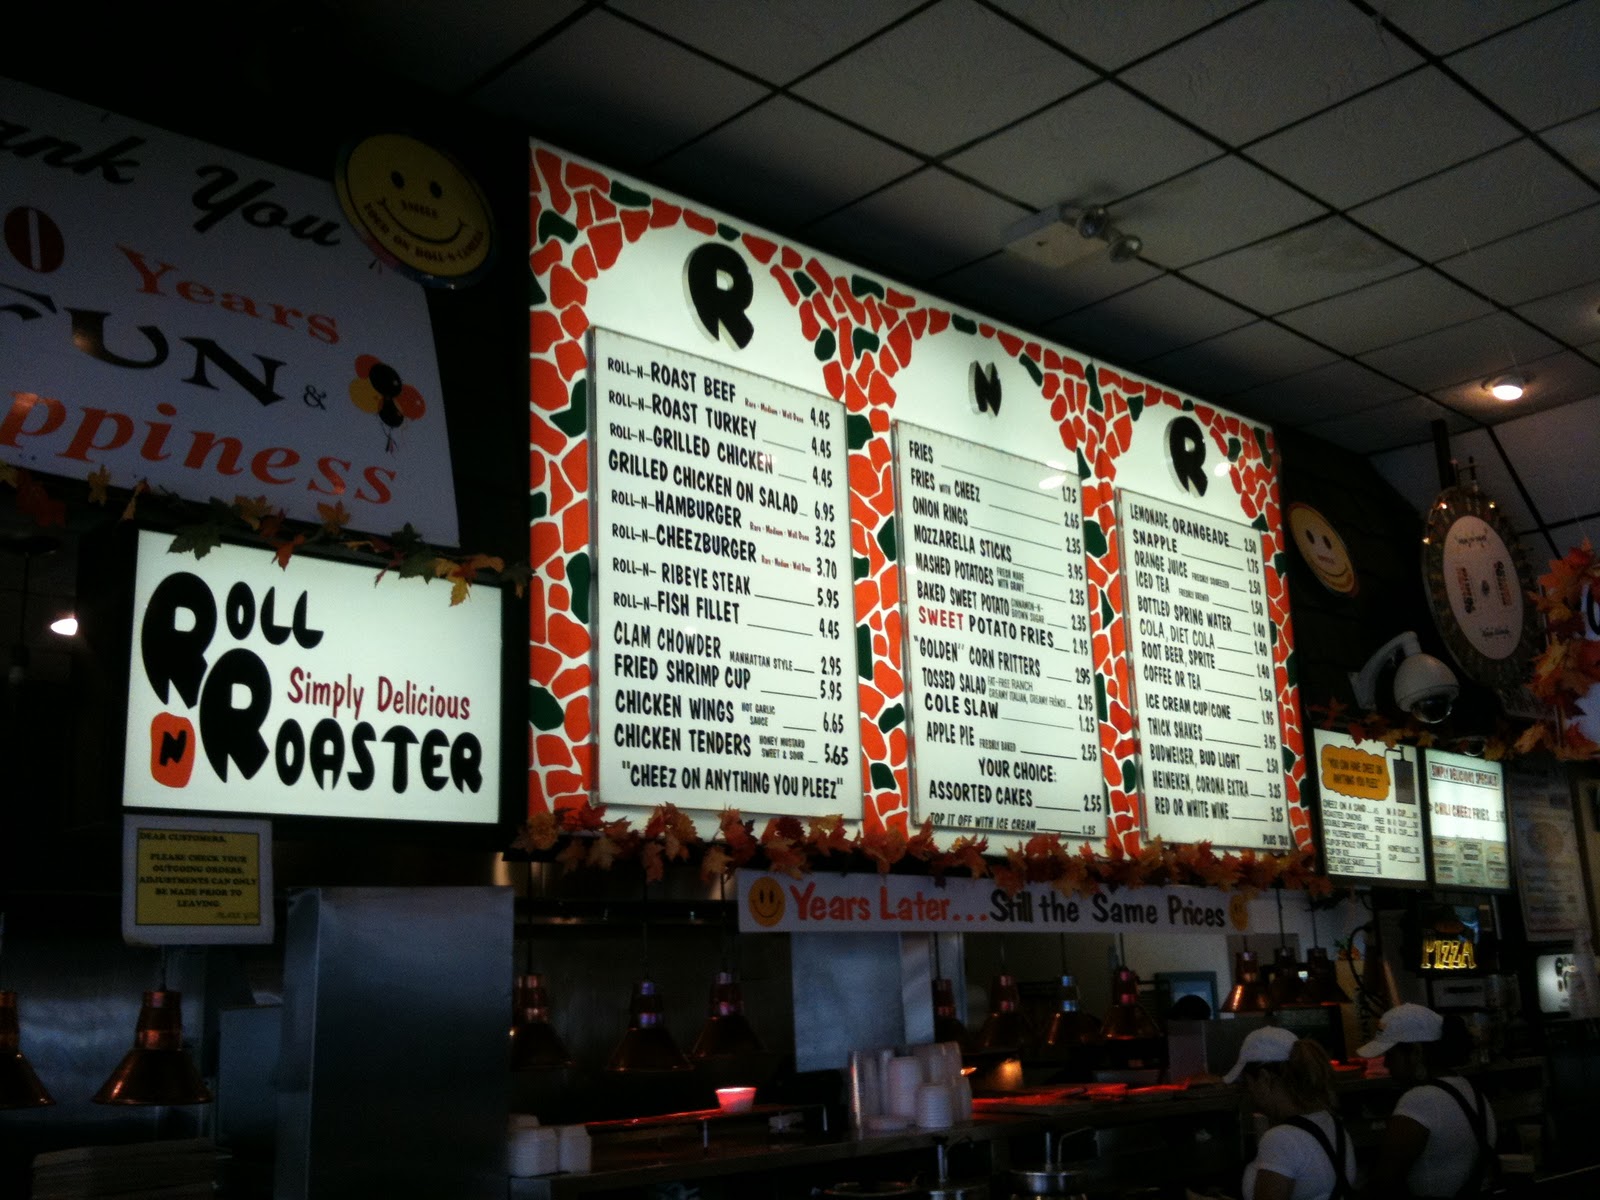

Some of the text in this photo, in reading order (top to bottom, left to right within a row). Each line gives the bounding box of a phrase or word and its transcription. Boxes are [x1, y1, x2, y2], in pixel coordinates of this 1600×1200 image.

[192, 165, 341, 247] You
[115, 243, 340, 345] Years
[688, 242, 754, 349] R
[303, 385, 327, 411] &
[703, 375, 736, 403] BEEF
[810, 407, 830, 430] 4.45
[970, 361, 1003, 417] N
[705, 407, 756, 440] TURKEY
[811, 436, 832, 459] 4.45
[716, 441, 773, 474] CHICKEN
[812, 465, 833, 488] 4.45
[908, 440, 933, 464] FRIES
[1167, 416, 1208, 498] R
[608, 448, 835, 522] GRILLED CHICKEN ON SALAD 6.95
[910, 467, 980, 503] FRIES CHEEZ
[912, 495, 968, 526] ONION RINGS
[815, 525, 836, 549] 3.25
[913, 524, 1012, 563] MOZZARELLA STICKS
[1132, 528, 1177, 553] SNAPPLE
[1172, 516, 1230, 548] ORANGEADE
[816, 556, 837, 580] 3.70
[915, 552, 994, 586] MASHED POTATOES
[1134, 549, 1188, 578] ORANGE JUICE
[661, 562, 708, 589] RIBEYE
[711, 570, 751, 595] STEAK
[817, 587, 839, 609] 5.95
[916, 579, 1010, 617] BAKED SWEET POTATO
[1135, 570, 1153, 589] ICED
[1155, 574, 1170, 593] TEA
[696, 596, 740, 624] FILLET
[819, 617, 840, 640] 4.45
[918, 605, 963, 630] SWEET
[968, 614, 1017, 640] POTATO
[1020, 625, 1054, 648] FRIES
[1137, 594, 1170, 617] BOTTLED
[1173, 604, 1203, 626] SPRING
[1206, 612, 1232, 632] WATER
[141, 571, 324, 709] ROLL
[613, 620, 842, 676] CLAM CHOWDER MANHATTAN STYLE 2.95
[1169, 625, 1189, 644] DIET
[1192, 629, 1215, 649] COLA
[968, 645, 995, 669] CORN
[997, 651, 1040, 678] FRITTERS
[1141, 640, 1162, 660] ROOT
[1188, 649, 1215, 669] SPRITE
[287, 666, 471, 720] Simply Delicious
[614, 653, 842, 701] FRIED SHRIMP CUP 5.95
[921, 666, 955, 690] TOSSED
[959, 672, 986, 695] SALAD
[1143, 664, 1201, 690] COFFEE OR TEA
[615, 689, 844, 734] CHICKEN WINGS 6.65
[924, 692, 960, 714] COLE
[963, 697, 998, 719] SLAW
[1145, 692, 1160, 709] ICE
[1161, 695, 1191, 713] CREAM
[159, 648, 483, 794] N ROASTER
[926, 720, 975, 746] APPLE PIE
[1147, 717, 1203, 741] THICK SHAKES
[613, 722, 848, 766] CHICKEN TENDERS 5.65
[1199, 748, 1216, 766] BUD
[1217, 751, 1240, 769] LIGHT
[681, 767, 701, 789] ON
[704, 768, 770, 794] ANYTHING
[773, 773, 799, 796] YOU
[978, 757, 1057, 783] YOUR CHOICE:
[1195, 774, 1249, 797] CORONA EXTRA
[928, 779, 992, 804] ASSORTED
[995, 786, 1033, 807] CAKES
[1154, 795, 1170, 815] RED
[1172, 798, 1184, 816] OR
[931, 812, 1036, 831] TOP IT OFF WITH ICE CREAM
[789, 881, 870, 921] Years
[989, 888, 1034, 922] Still
[1039, 896, 1080, 924] the
[1091, 894, 1158, 926] Same
[1167, 898, 1226, 928] Prices
[1421, 938, 1478, 970] PIZZA
